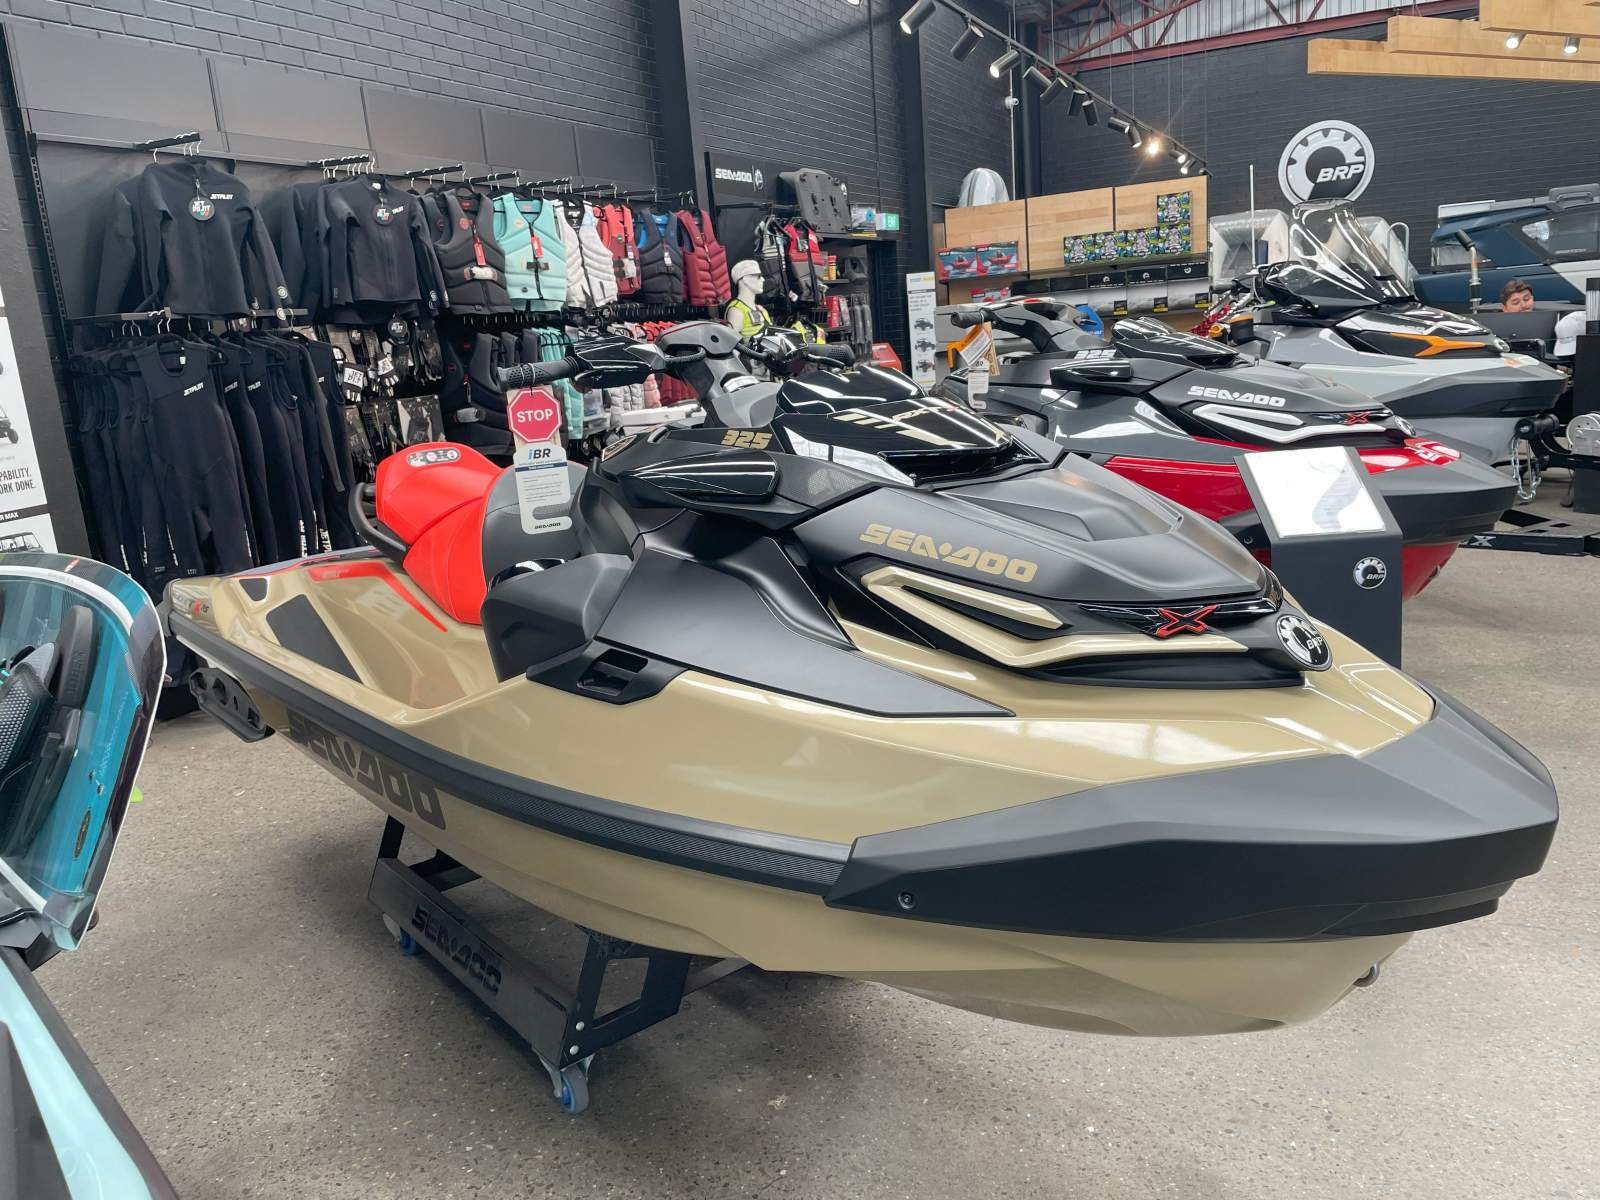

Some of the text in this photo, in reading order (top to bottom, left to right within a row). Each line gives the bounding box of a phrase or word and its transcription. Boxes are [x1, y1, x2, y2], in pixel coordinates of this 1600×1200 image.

[1316, 164, 1365, 183] BRP
[1074, 349, 1117, 360] 325
[516, 408, 553, 423] STOP
[720, 429, 773, 449] 325
[5, 511, 19, 519] MAX
